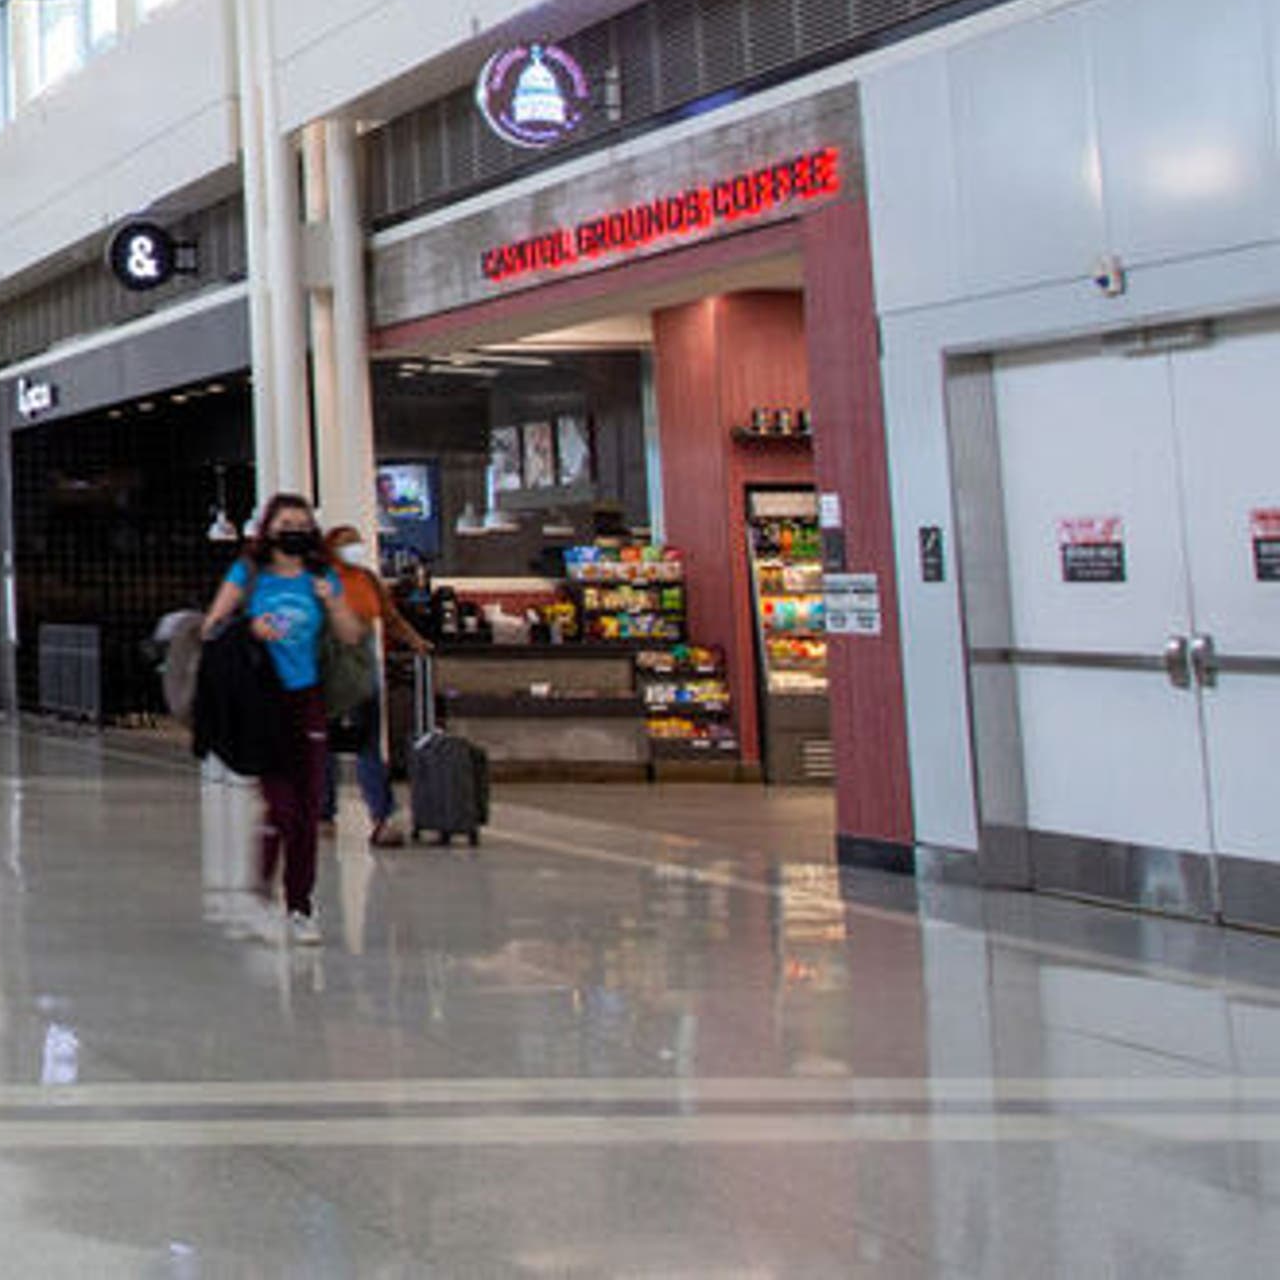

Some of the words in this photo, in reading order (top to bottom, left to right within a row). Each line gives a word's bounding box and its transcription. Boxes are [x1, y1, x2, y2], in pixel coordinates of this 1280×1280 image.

[576, 190, 715, 258] GROUNDS
[710, 148, 840, 219] COFFEE
[127, 235, 159, 277] &
